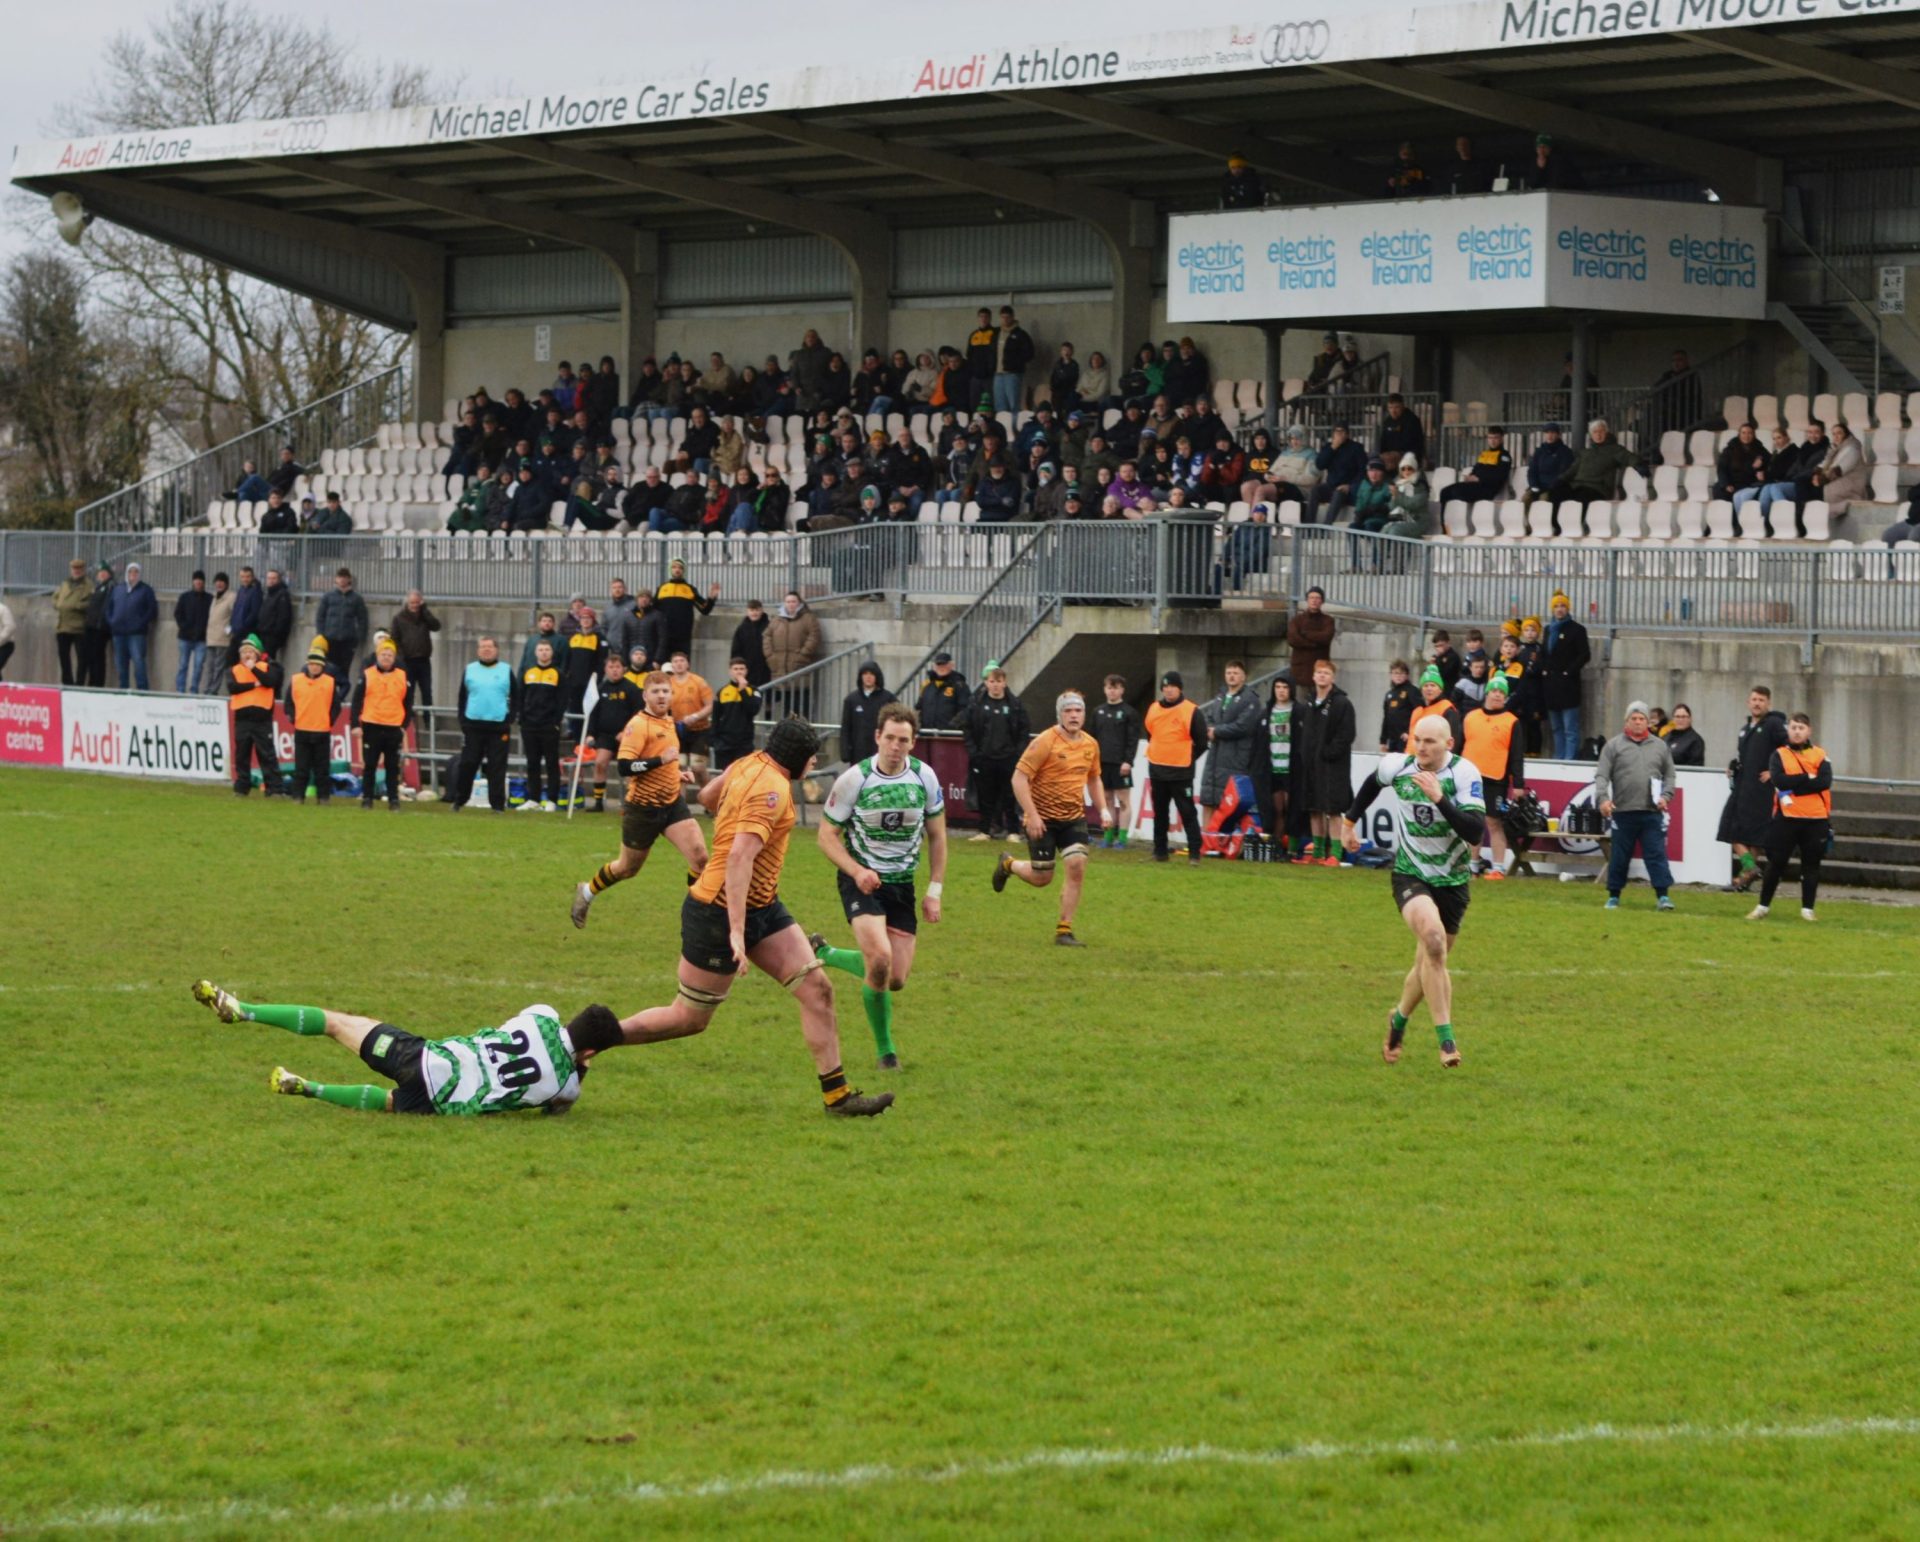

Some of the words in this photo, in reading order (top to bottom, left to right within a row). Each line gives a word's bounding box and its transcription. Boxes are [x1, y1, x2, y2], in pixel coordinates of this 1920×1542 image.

[1500, 0, 1661, 42] Michael
[1230, 32, 1256, 46] Audi
[913, 54, 986, 93] Audi
[991, 47, 1119, 86] Athlone
[1126, 56, 1178, 73] Vorsprung
[1215, 50, 1253, 65] Technik
[428, 100, 530, 139] Michael
[538, 95, 627, 129] Moore
[636, 86, 683, 119] Car
[690, 78, 769, 115] Sales
[57, 140, 106, 169] Audi
[107, 136, 192, 165] Athlone
[1268, 234, 1335, 262] electric
[1360, 228, 1432, 258] electric
[1457, 222, 1531, 252] electric
[1557, 226, 1646, 255] electric
[1669, 234, 1755, 263] electric
[1178, 240, 1244, 267] electric
[1469, 250, 1532, 281] Ireland
[1573, 250, 1646, 281] Ireland
[1188, 265, 1244, 294] Ireland
[1279, 260, 1336, 290] Ireland
[1372, 255, 1432, 286] Ireland
[1684, 256, 1756, 288] Ireland
[0, 698, 50, 729] shopping
[6, 730, 44, 751] centre
[70, 720, 120, 766] Audi
[128, 724, 224, 773] Athlone
[949, 783, 966, 800] for
[485, 1029, 542, 1089] 20
